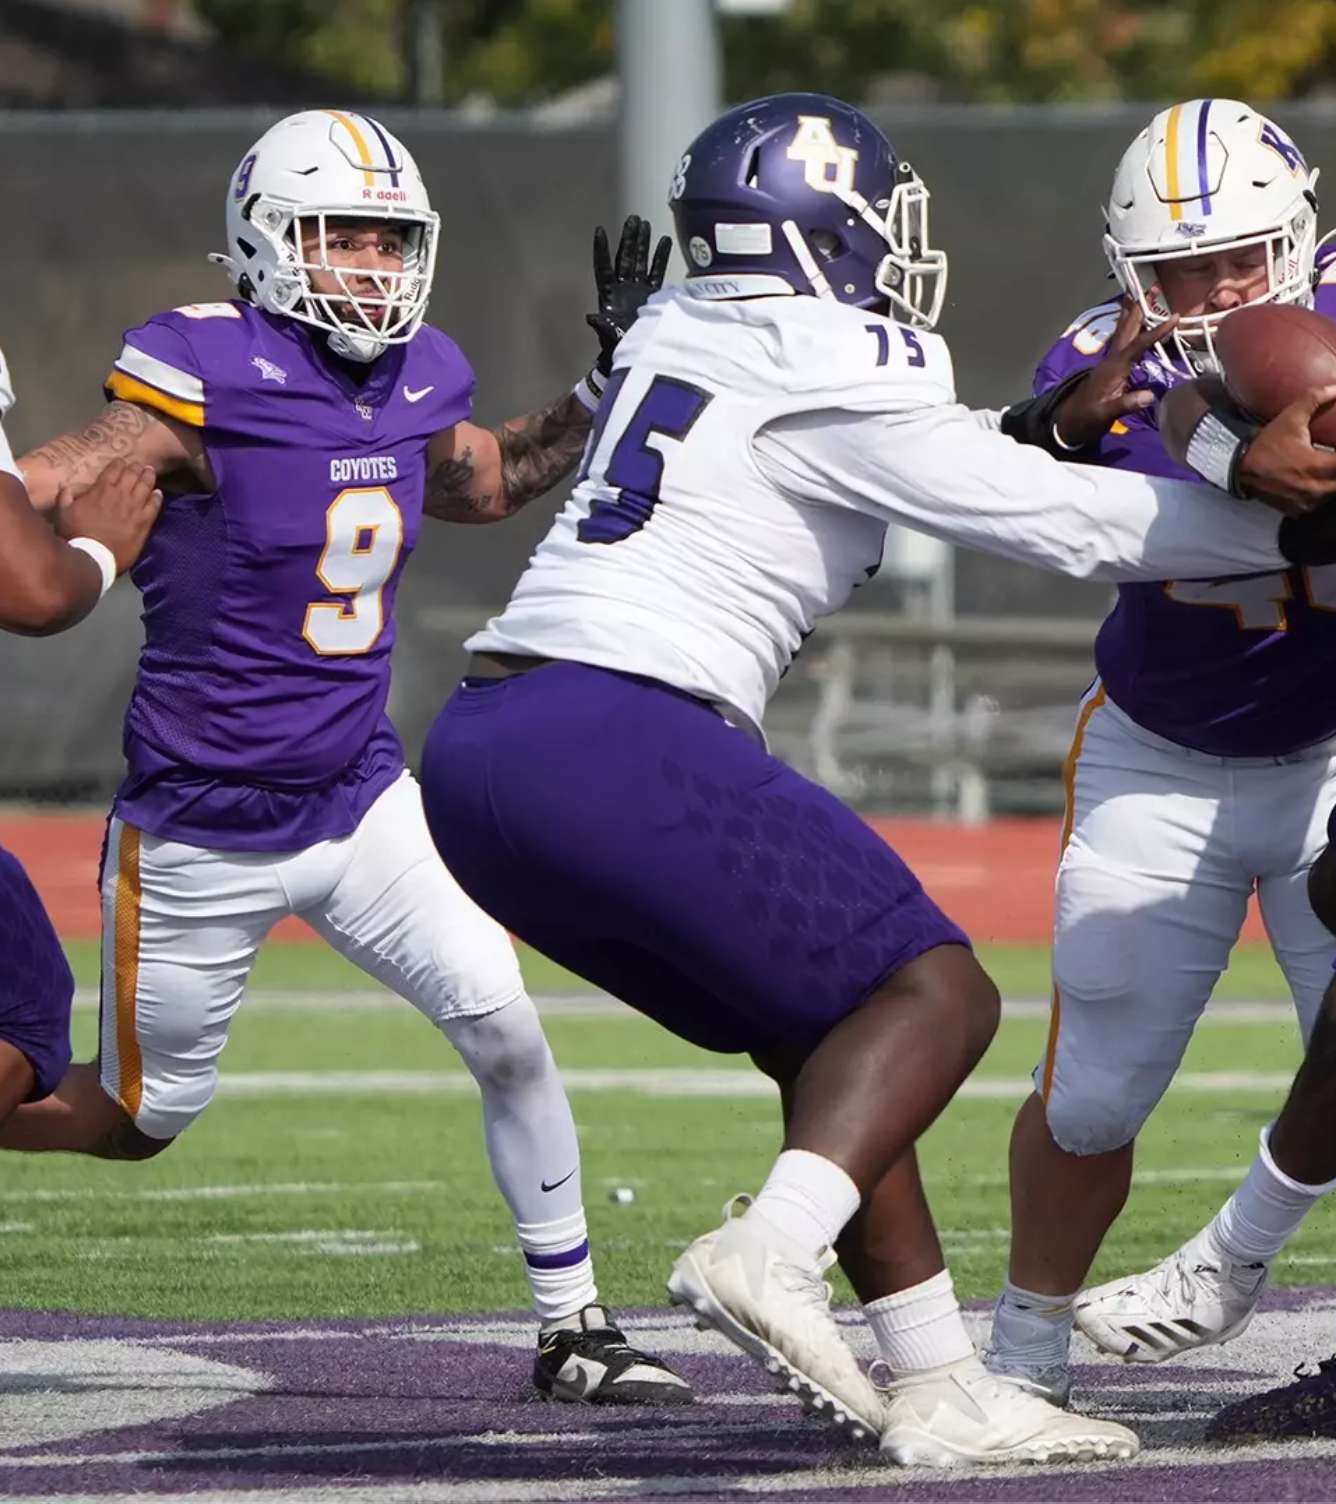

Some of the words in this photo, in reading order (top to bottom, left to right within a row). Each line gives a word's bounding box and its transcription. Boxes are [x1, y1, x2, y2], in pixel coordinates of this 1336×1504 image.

[234, 153, 257, 199] 9
[362, 189, 407, 201] Rddell
[864, 324, 925, 368] 75
[330, 456, 397, 481] COYOTES
[302, 486, 403, 656] 9
